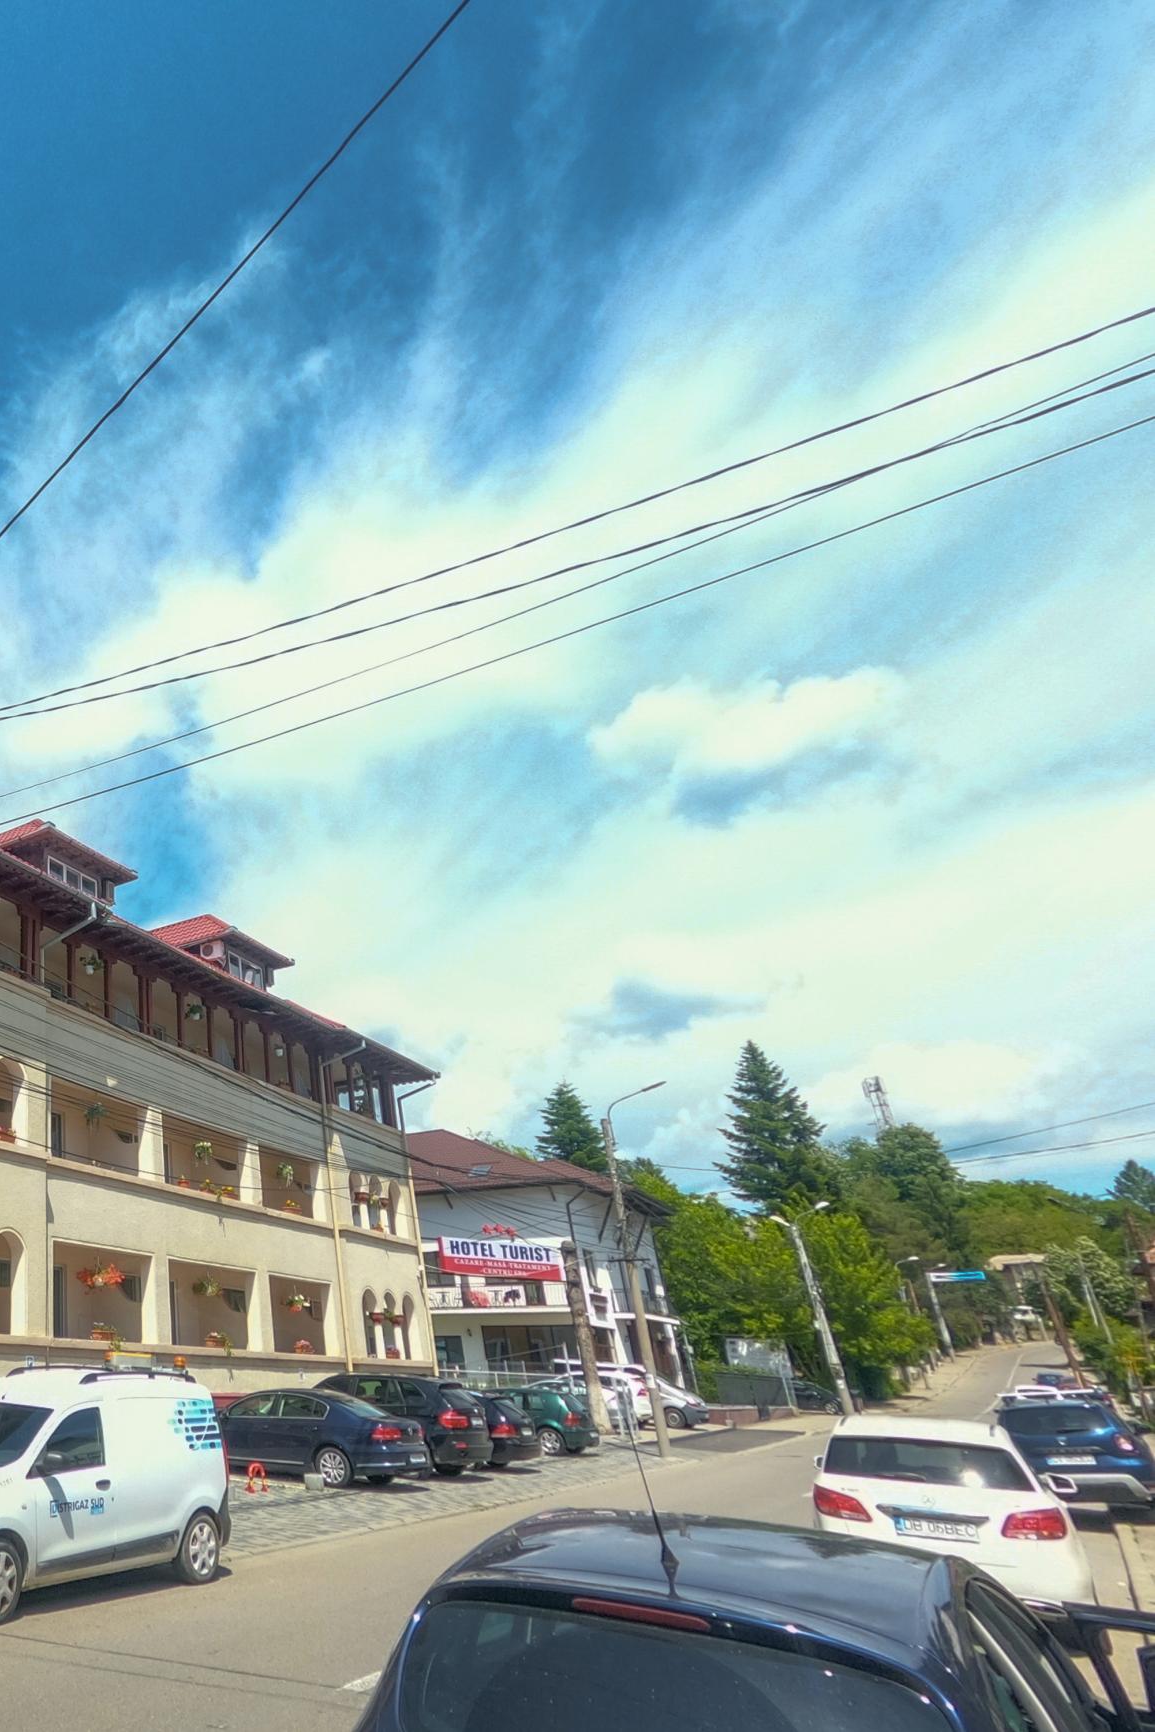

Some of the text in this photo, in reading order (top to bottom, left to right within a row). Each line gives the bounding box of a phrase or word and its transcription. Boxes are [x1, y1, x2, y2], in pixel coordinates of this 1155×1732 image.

[450, 1240, 551, 1262] HOTEL TURIST
[90, 1497, 104, 1508] SUD
[904, 1519, 923, 1532] DB
